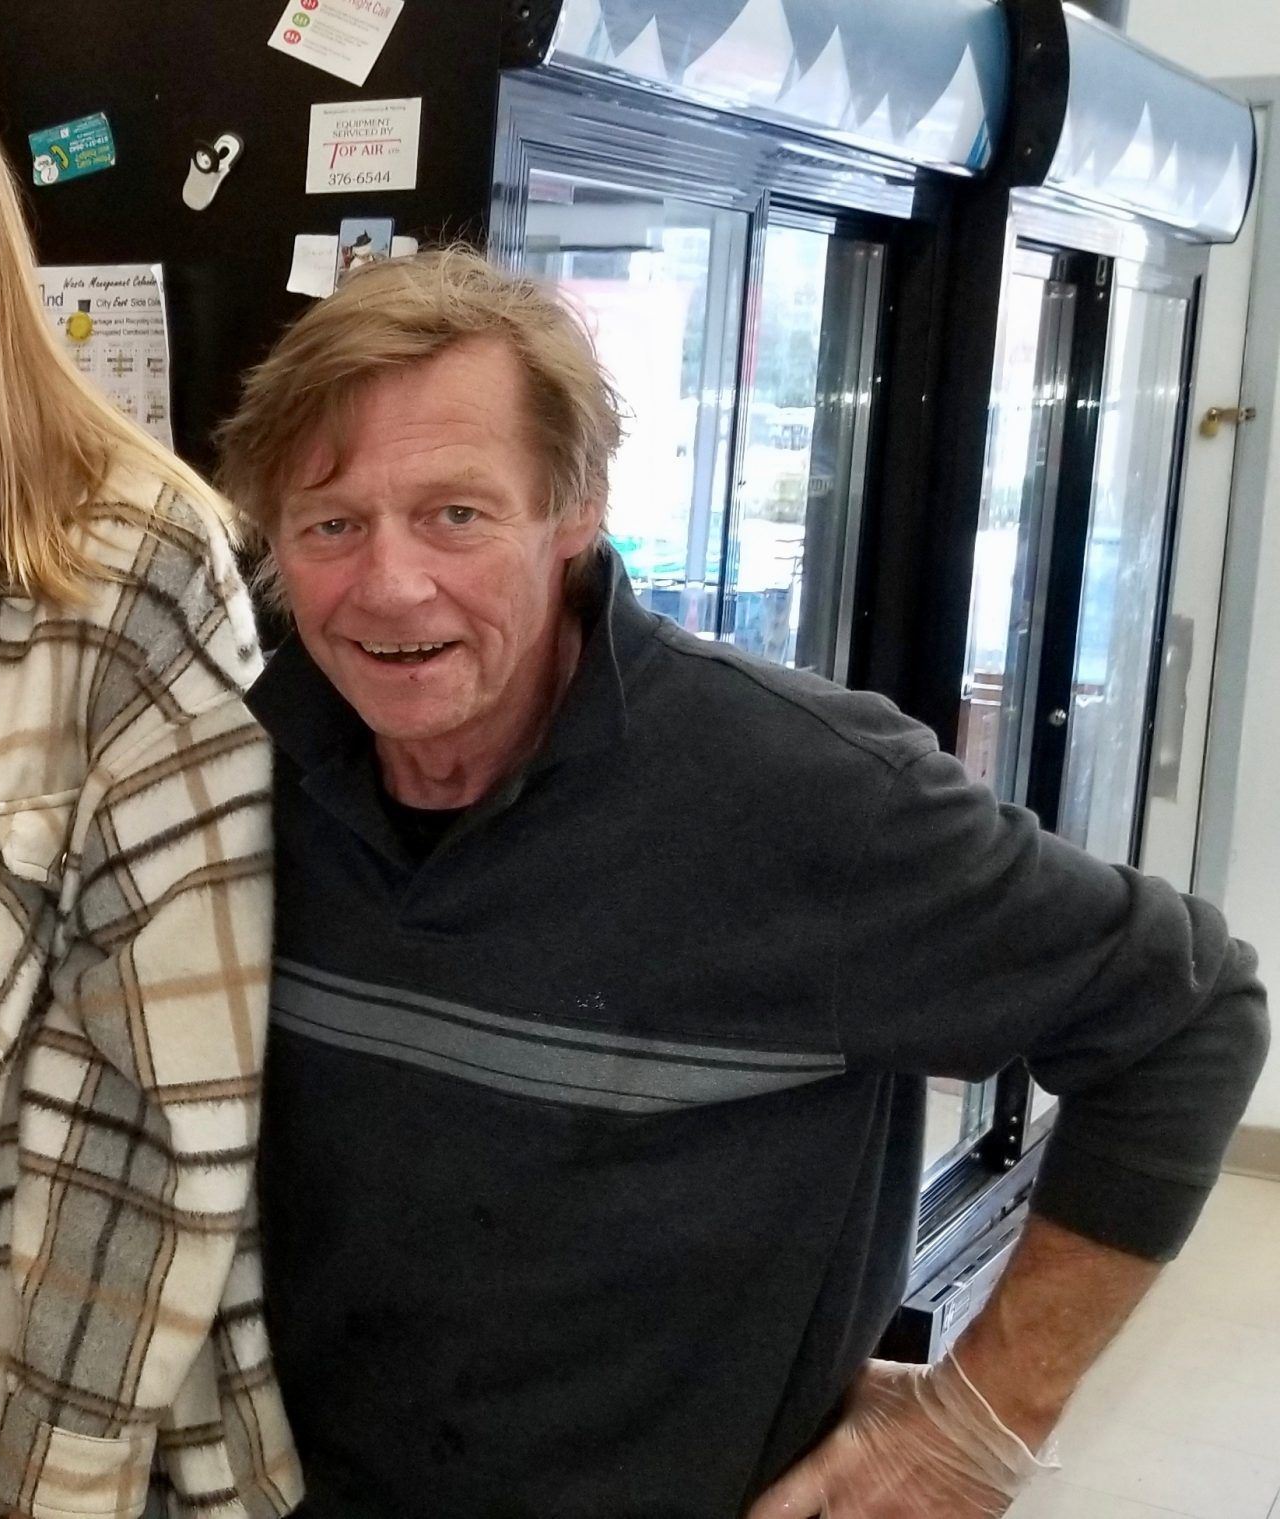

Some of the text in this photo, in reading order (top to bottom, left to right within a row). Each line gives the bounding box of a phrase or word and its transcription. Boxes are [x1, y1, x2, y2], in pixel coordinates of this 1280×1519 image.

[336, 118, 391, 129] EQUIPMENT
[333, 127, 394, 138] SERVICED BY
[361, 144, 384, 156] AIR
[328, 170, 391, 186] 376-6544
